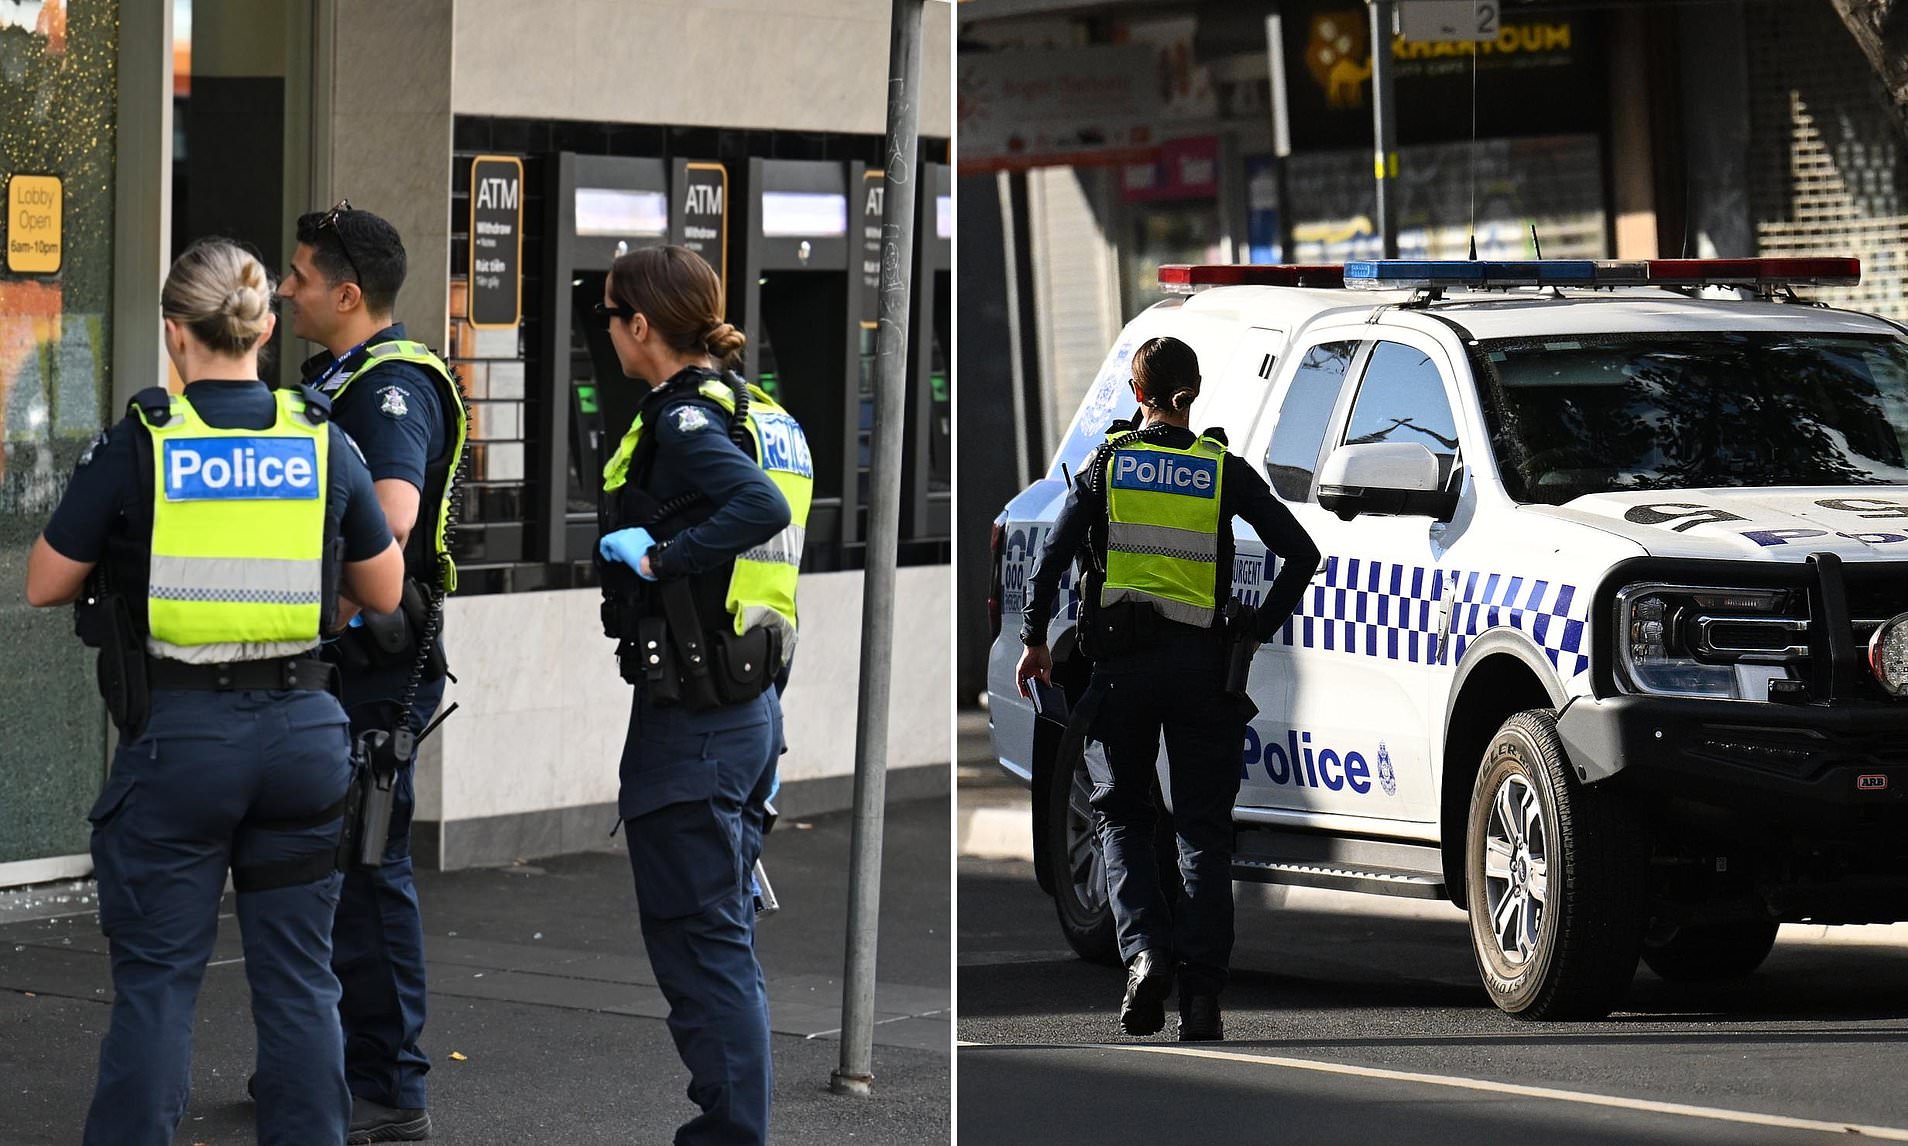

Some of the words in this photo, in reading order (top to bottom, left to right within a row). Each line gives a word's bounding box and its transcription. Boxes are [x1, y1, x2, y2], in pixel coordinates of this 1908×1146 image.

[1476, 5, 1495, 33] 2
[17, 186, 55, 208] Lobby
[477, 177, 518, 210] ATM
[684, 184, 723, 216] ATM
[864, 186, 884, 215] AT
[19, 209, 51, 232] Open
[10, 239, 59, 256] 6am-10pm
[170, 447, 313, 489] Police
[1116, 455, 1211, 490] Police
[1005, 563, 1024, 590] 000
[1232, 558, 1262, 587] URGENT
[1240, 724, 1372, 795] Police
[1861, 777, 1884, 788] ARB
